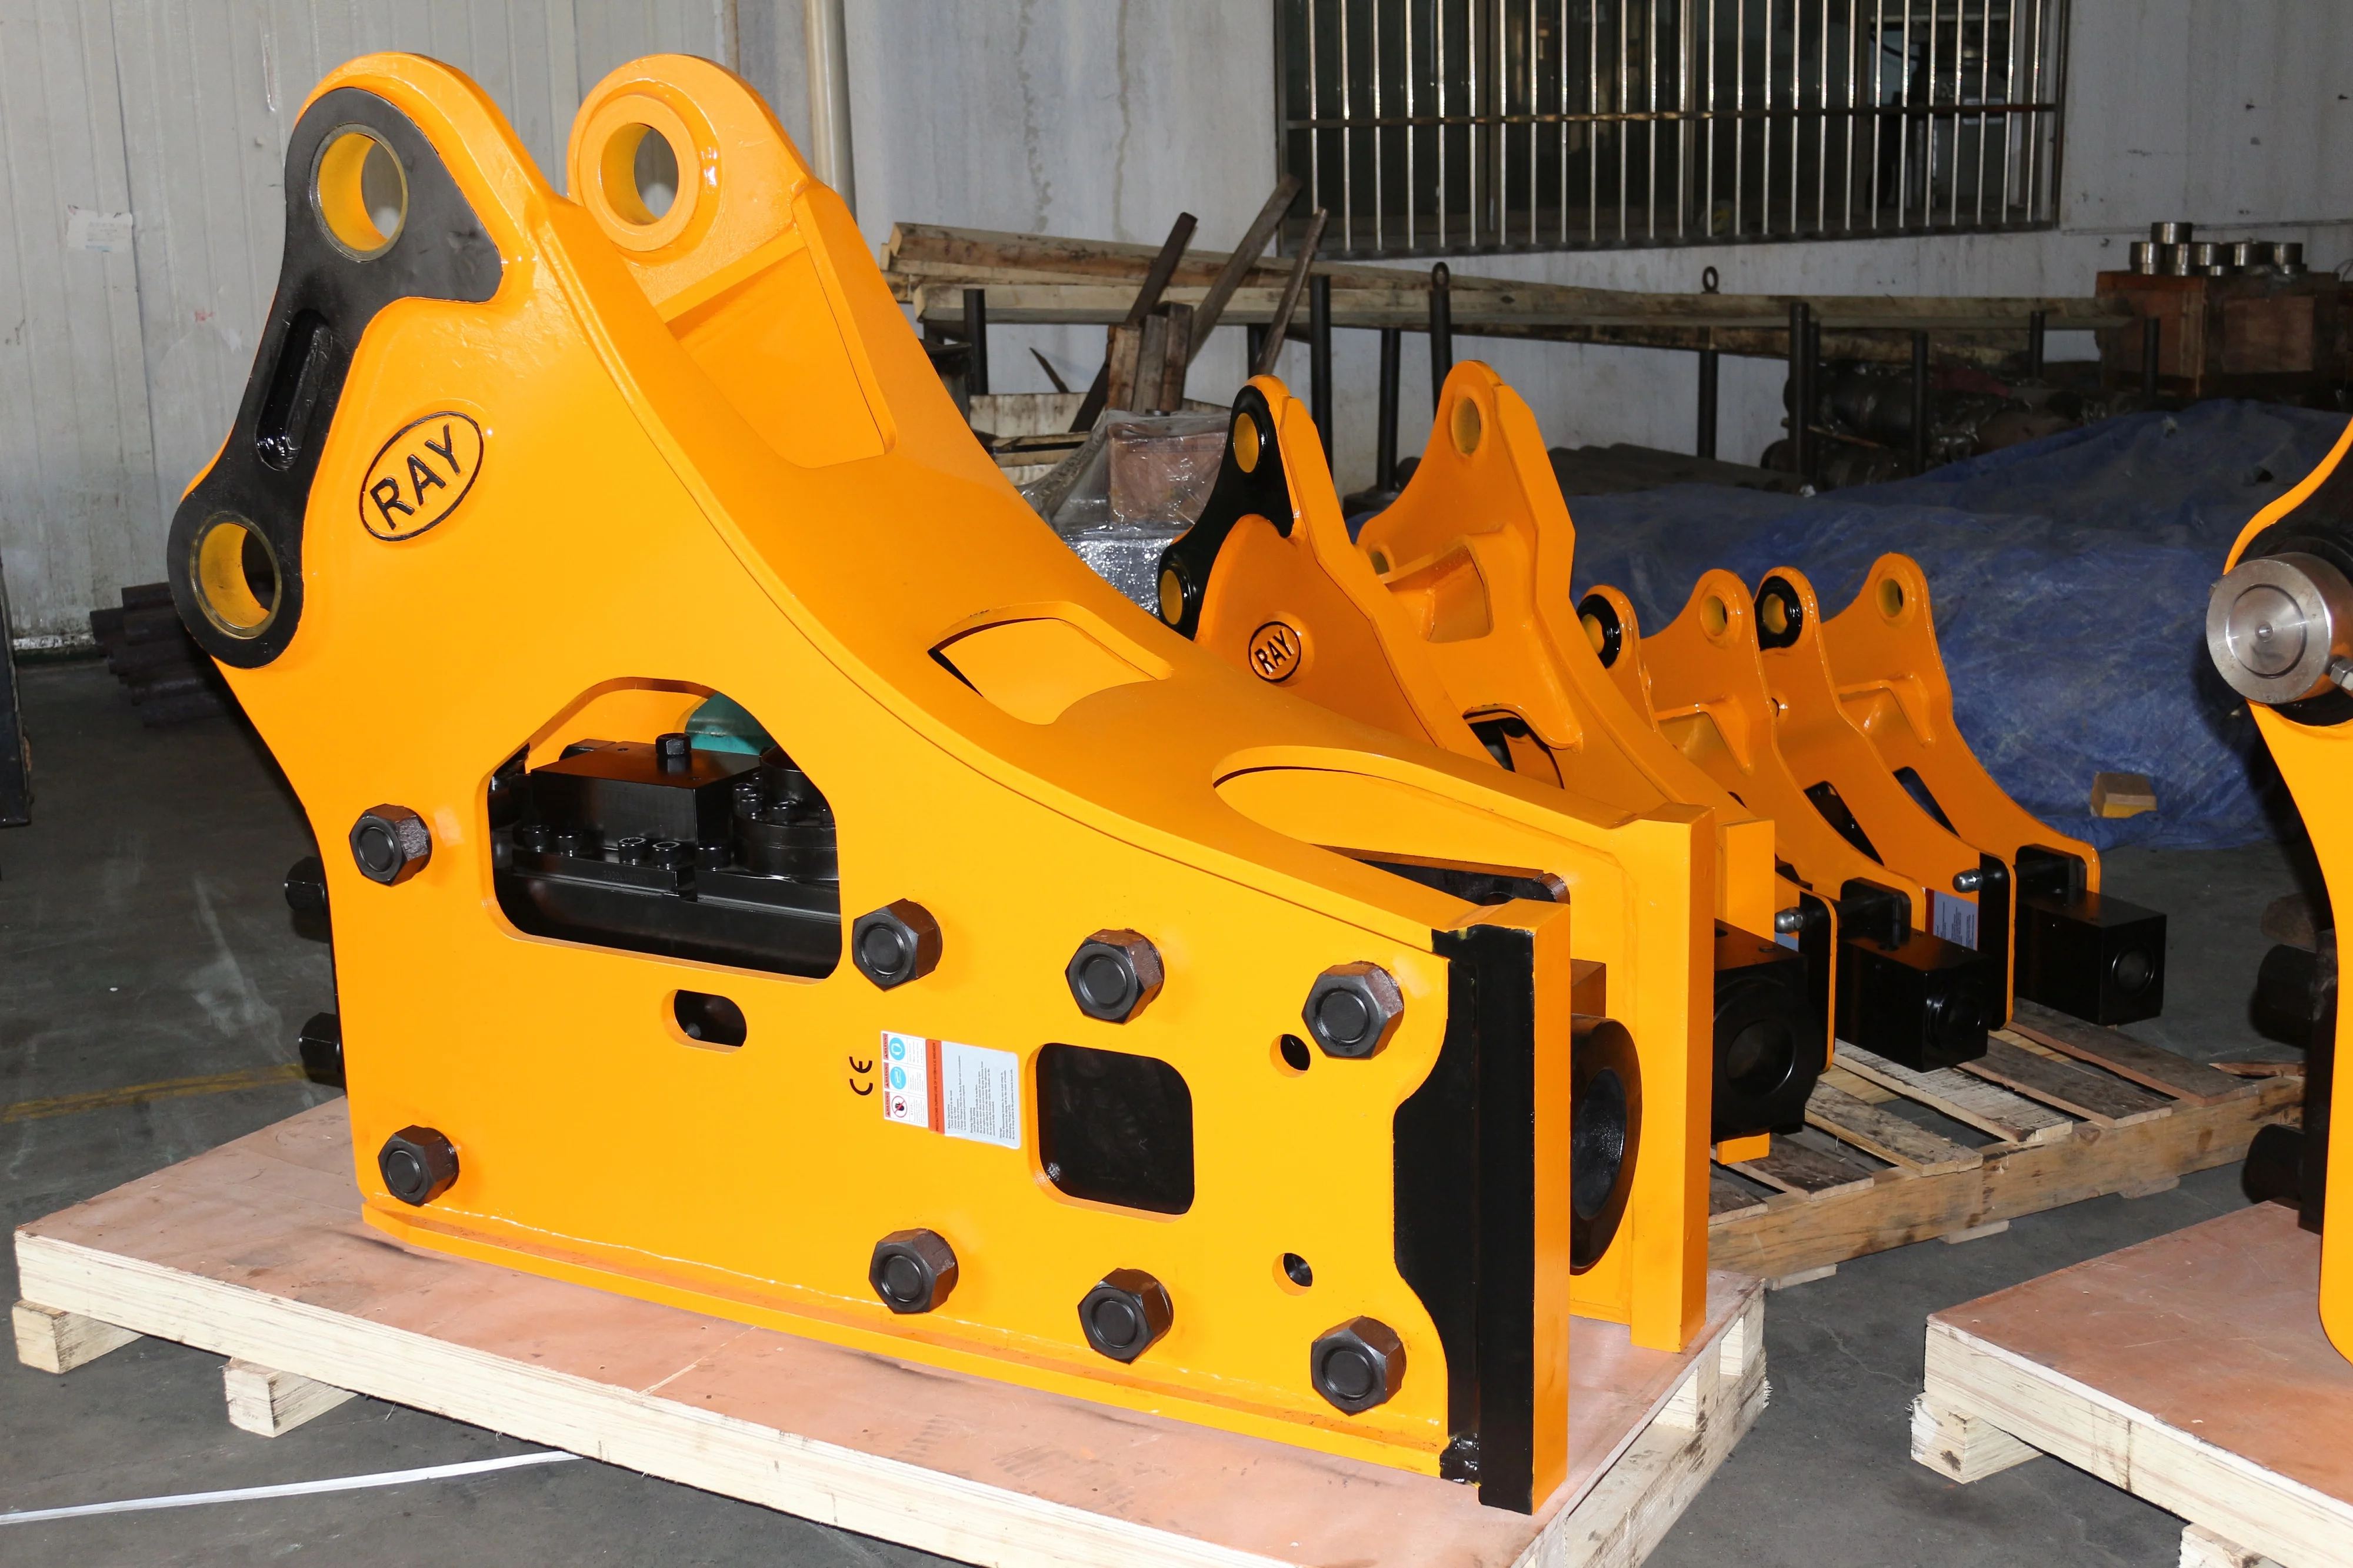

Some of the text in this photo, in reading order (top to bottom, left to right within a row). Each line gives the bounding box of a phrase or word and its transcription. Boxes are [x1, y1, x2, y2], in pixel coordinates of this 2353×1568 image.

[369, 423, 461, 531] RAY
[1254, 629, 1292, 675] RAY
[849, 1056, 873, 1096] CE
